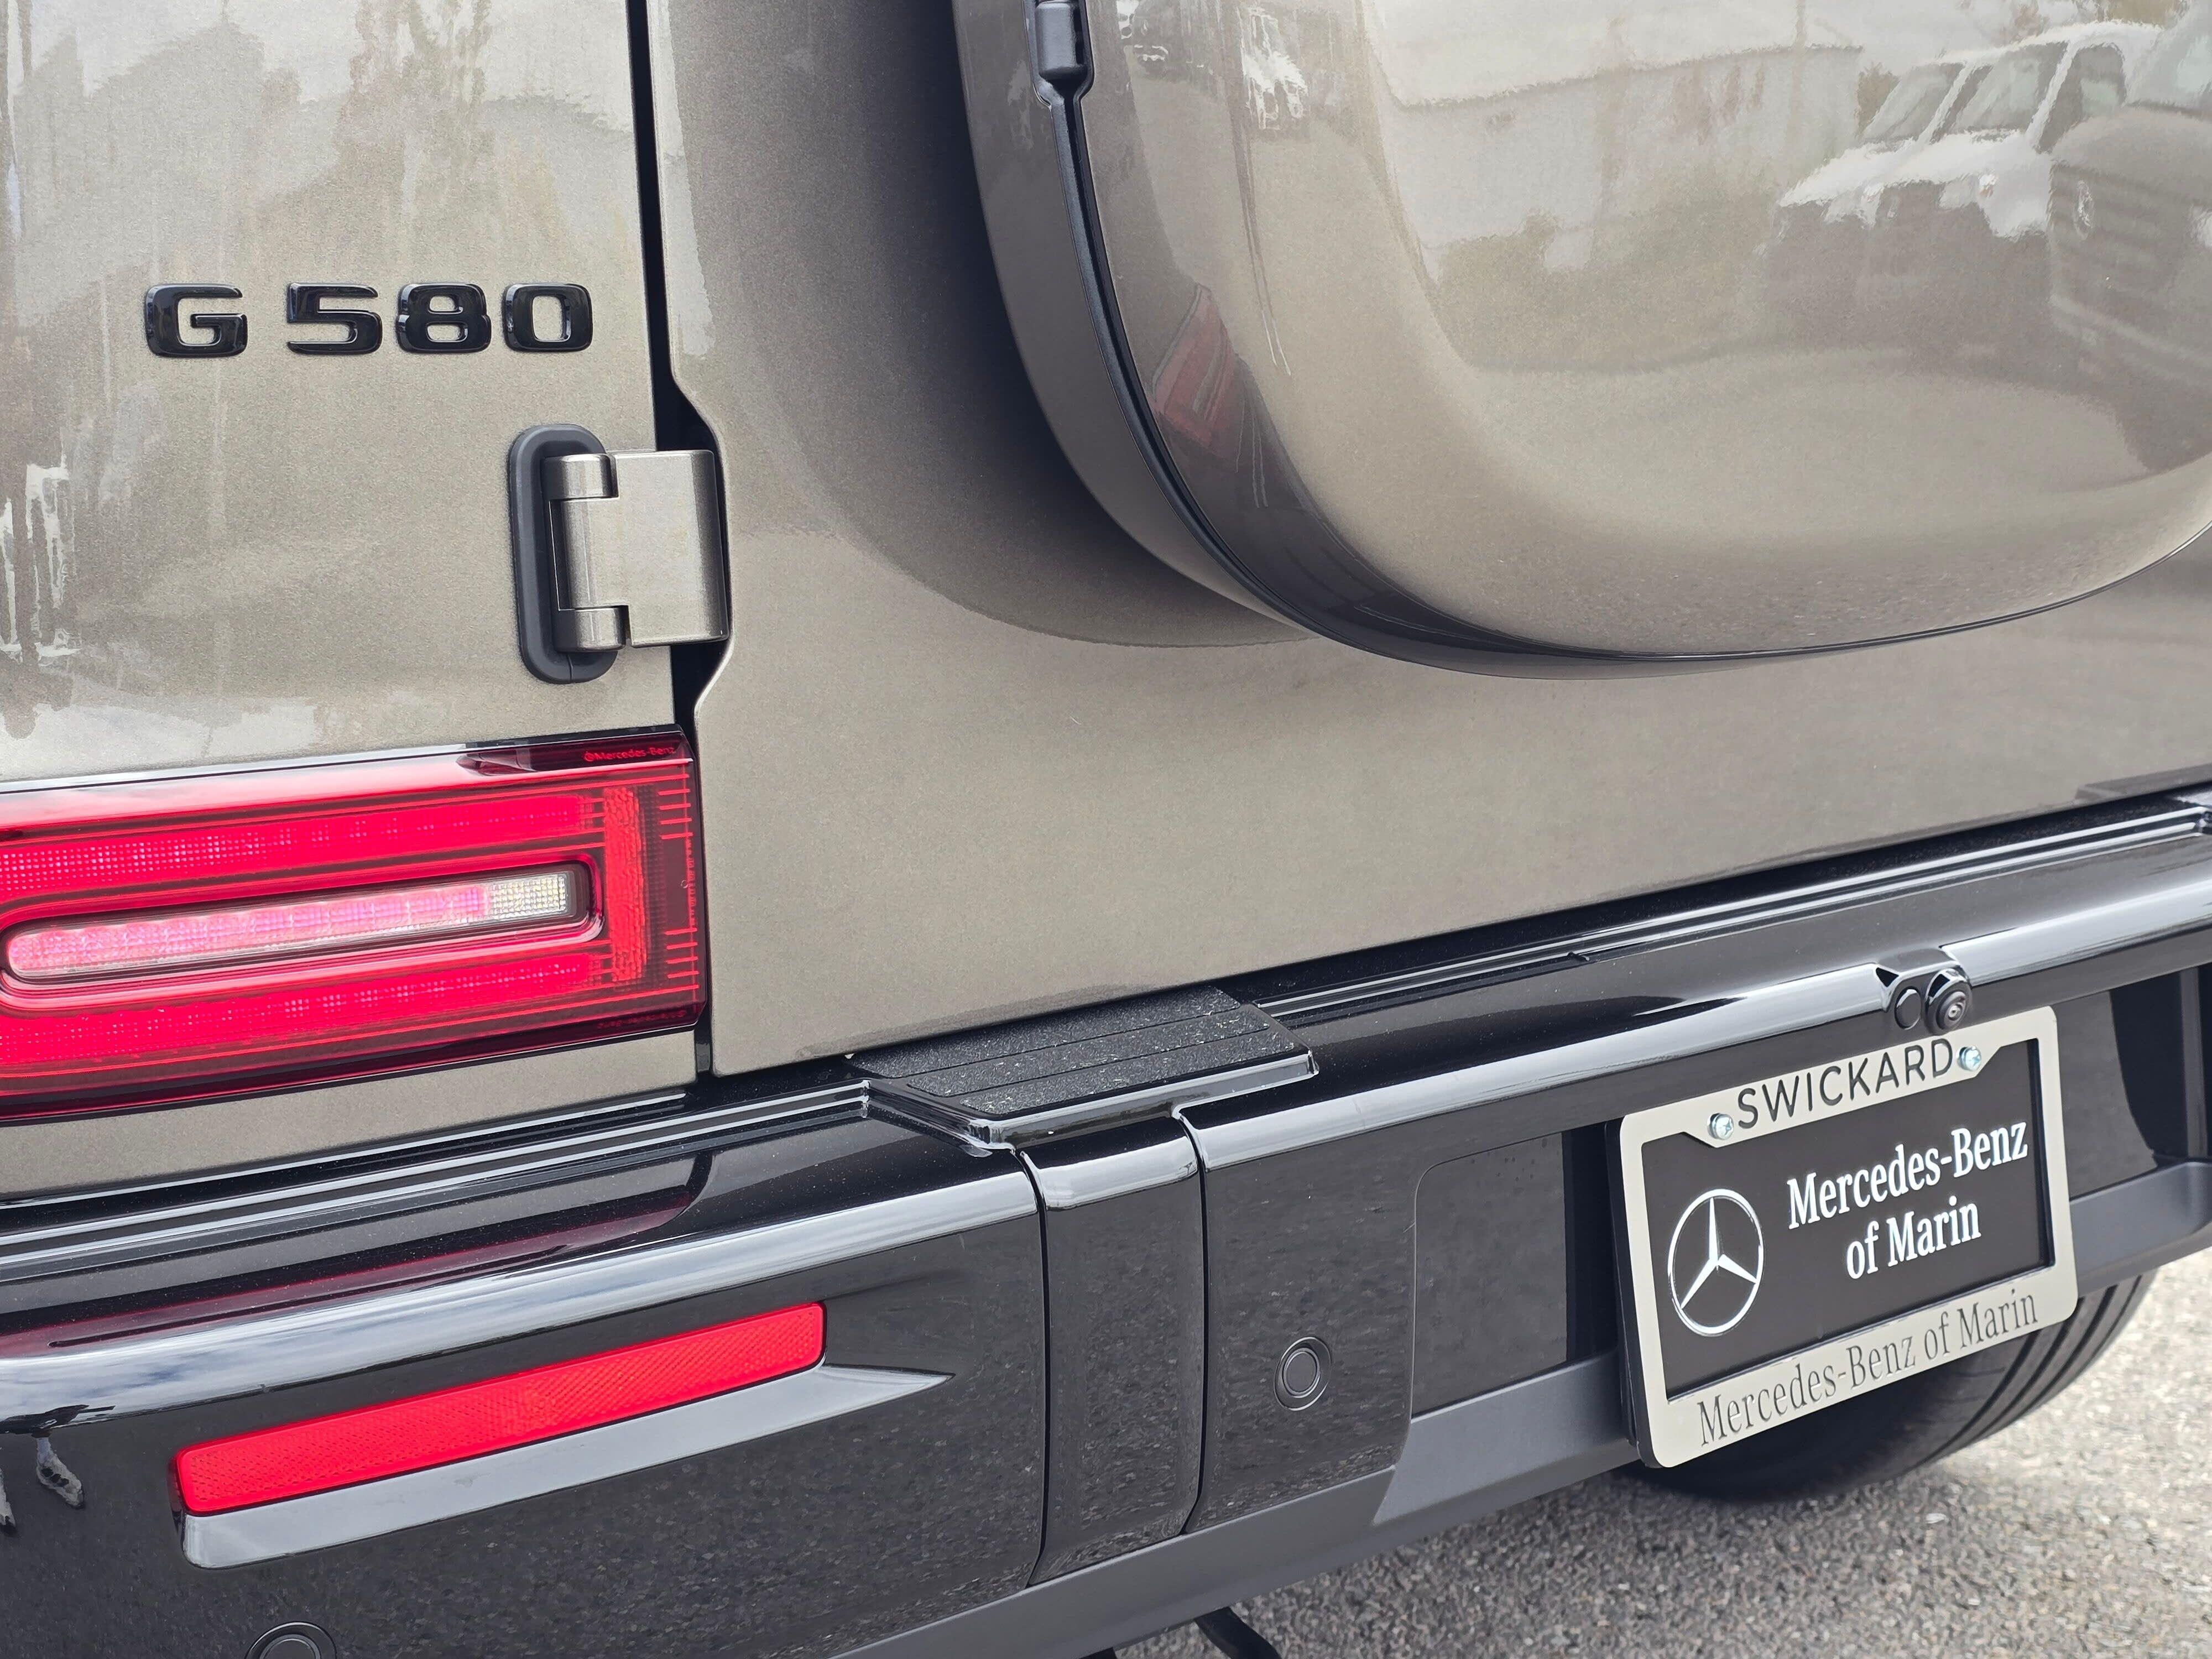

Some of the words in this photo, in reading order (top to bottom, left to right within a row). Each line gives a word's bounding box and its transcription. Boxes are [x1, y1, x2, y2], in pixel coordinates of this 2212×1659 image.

[145, 282, 248, 357] G
[286, 282, 593, 356] 580
[593, 747, 676, 760] Mercedes-Benz
[1737, 1039, 1953, 1129] SWICKARD
[1787, 1121, 2028, 1229] Mercedes-Benz
[1846, 1221, 1881, 1279] of
[1887, 1197, 1981, 1267] Marin
[1697, 1334, 1916, 1447] Mercedes-Benz
[1924, 1311, 1949, 1360] of
[1959, 1288, 2038, 1348] Marin
